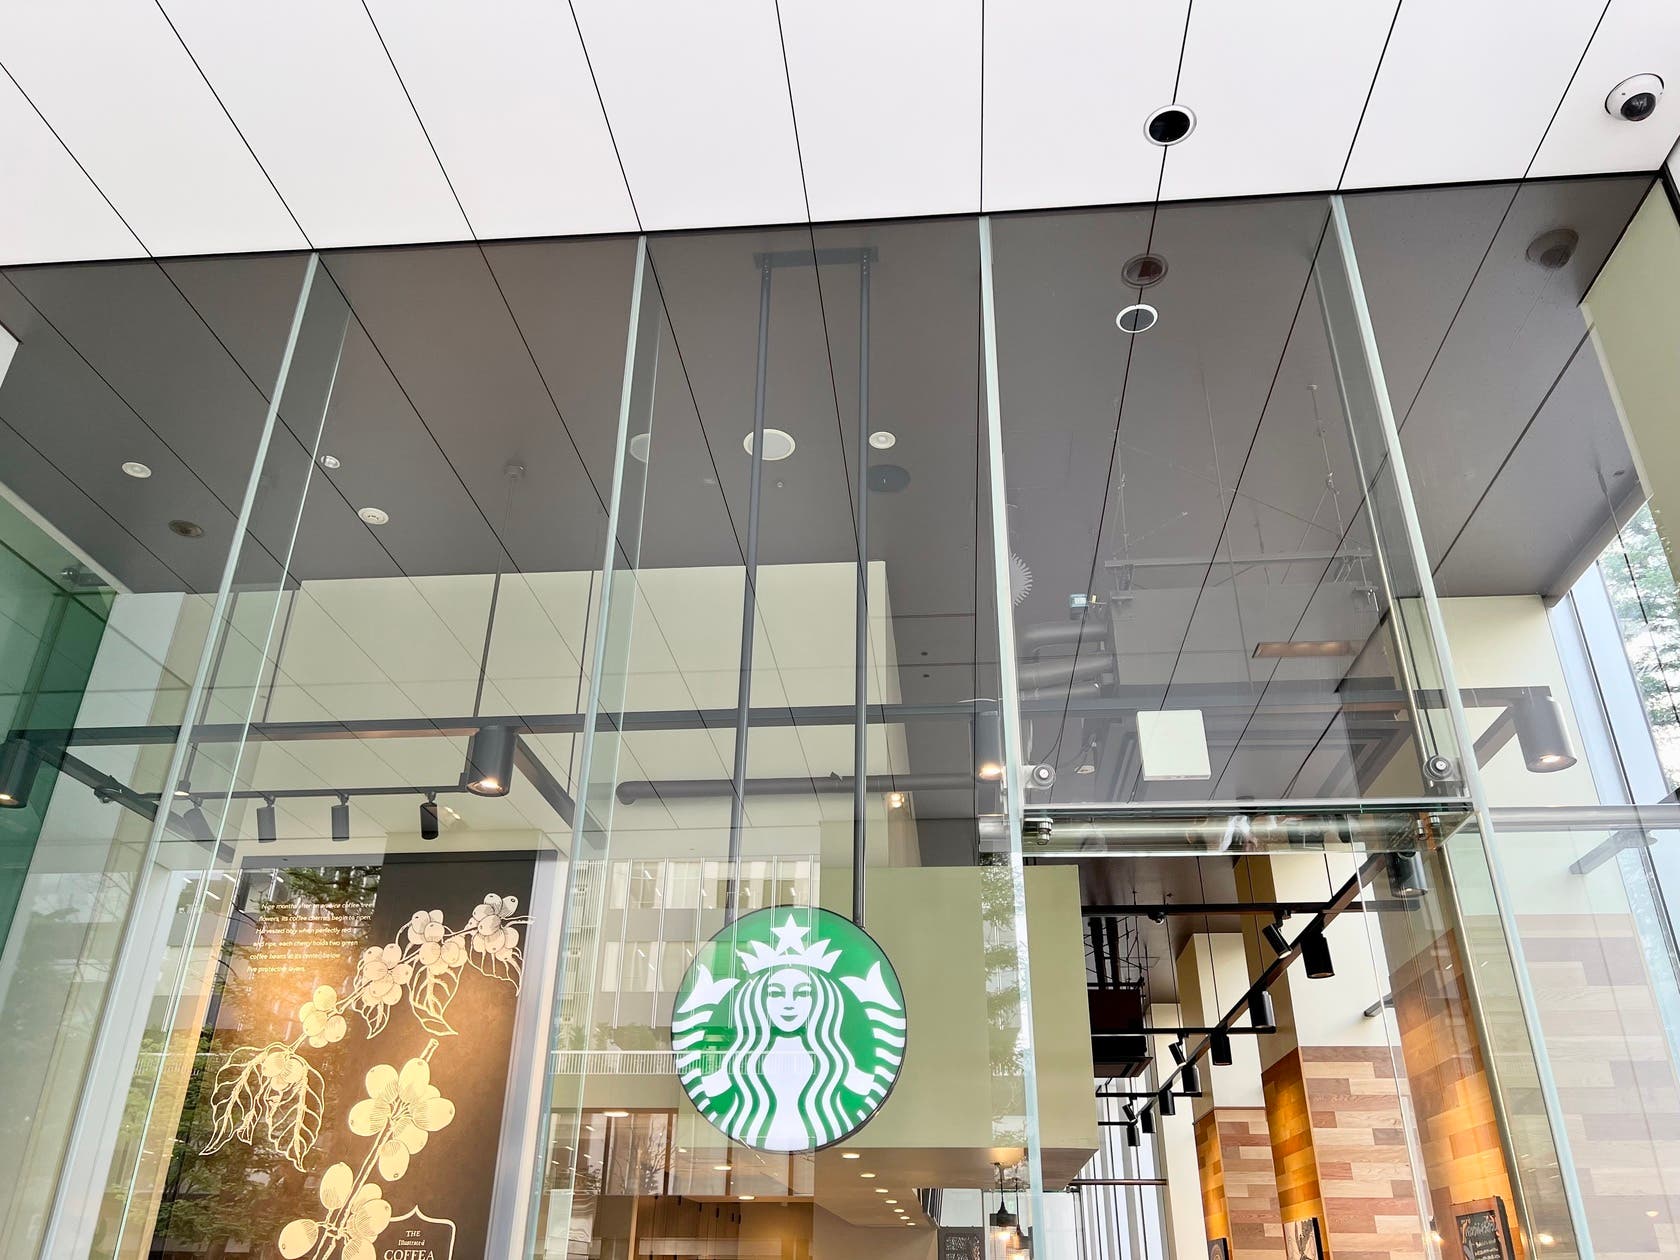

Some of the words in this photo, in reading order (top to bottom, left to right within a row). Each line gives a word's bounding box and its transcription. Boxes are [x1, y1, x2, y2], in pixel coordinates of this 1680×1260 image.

[315, 927, 340, 936] perfectly
[294, 940, 312, 948] cherry
[341, 940, 358, 948] green
[257, 966, 287, 974] protective
[384, 1249, 435, 1260] COFFEA
